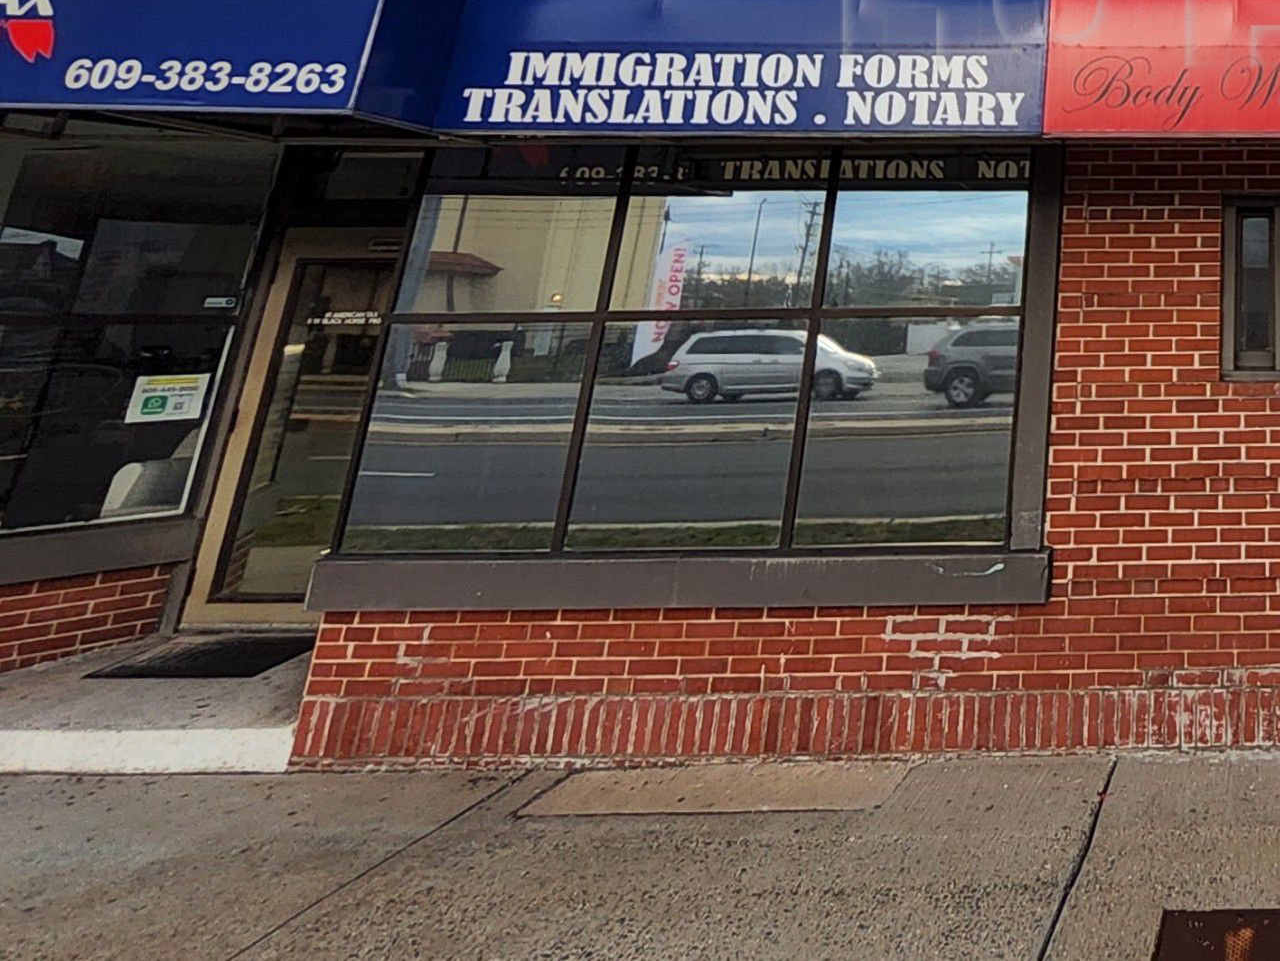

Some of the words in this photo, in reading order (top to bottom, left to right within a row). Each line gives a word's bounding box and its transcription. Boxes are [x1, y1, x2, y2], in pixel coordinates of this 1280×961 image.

[64, 58, 347, 95] 609-383-8263
[503, 51, 824, 89] IMMIGRATION
[836, 52, 989, 90] FORMS
[462, 87, 799, 125] TRANSLATIONS
[842, 90, 1026, 127] NOTARY
[1062, 53, 1202, 129] Body
